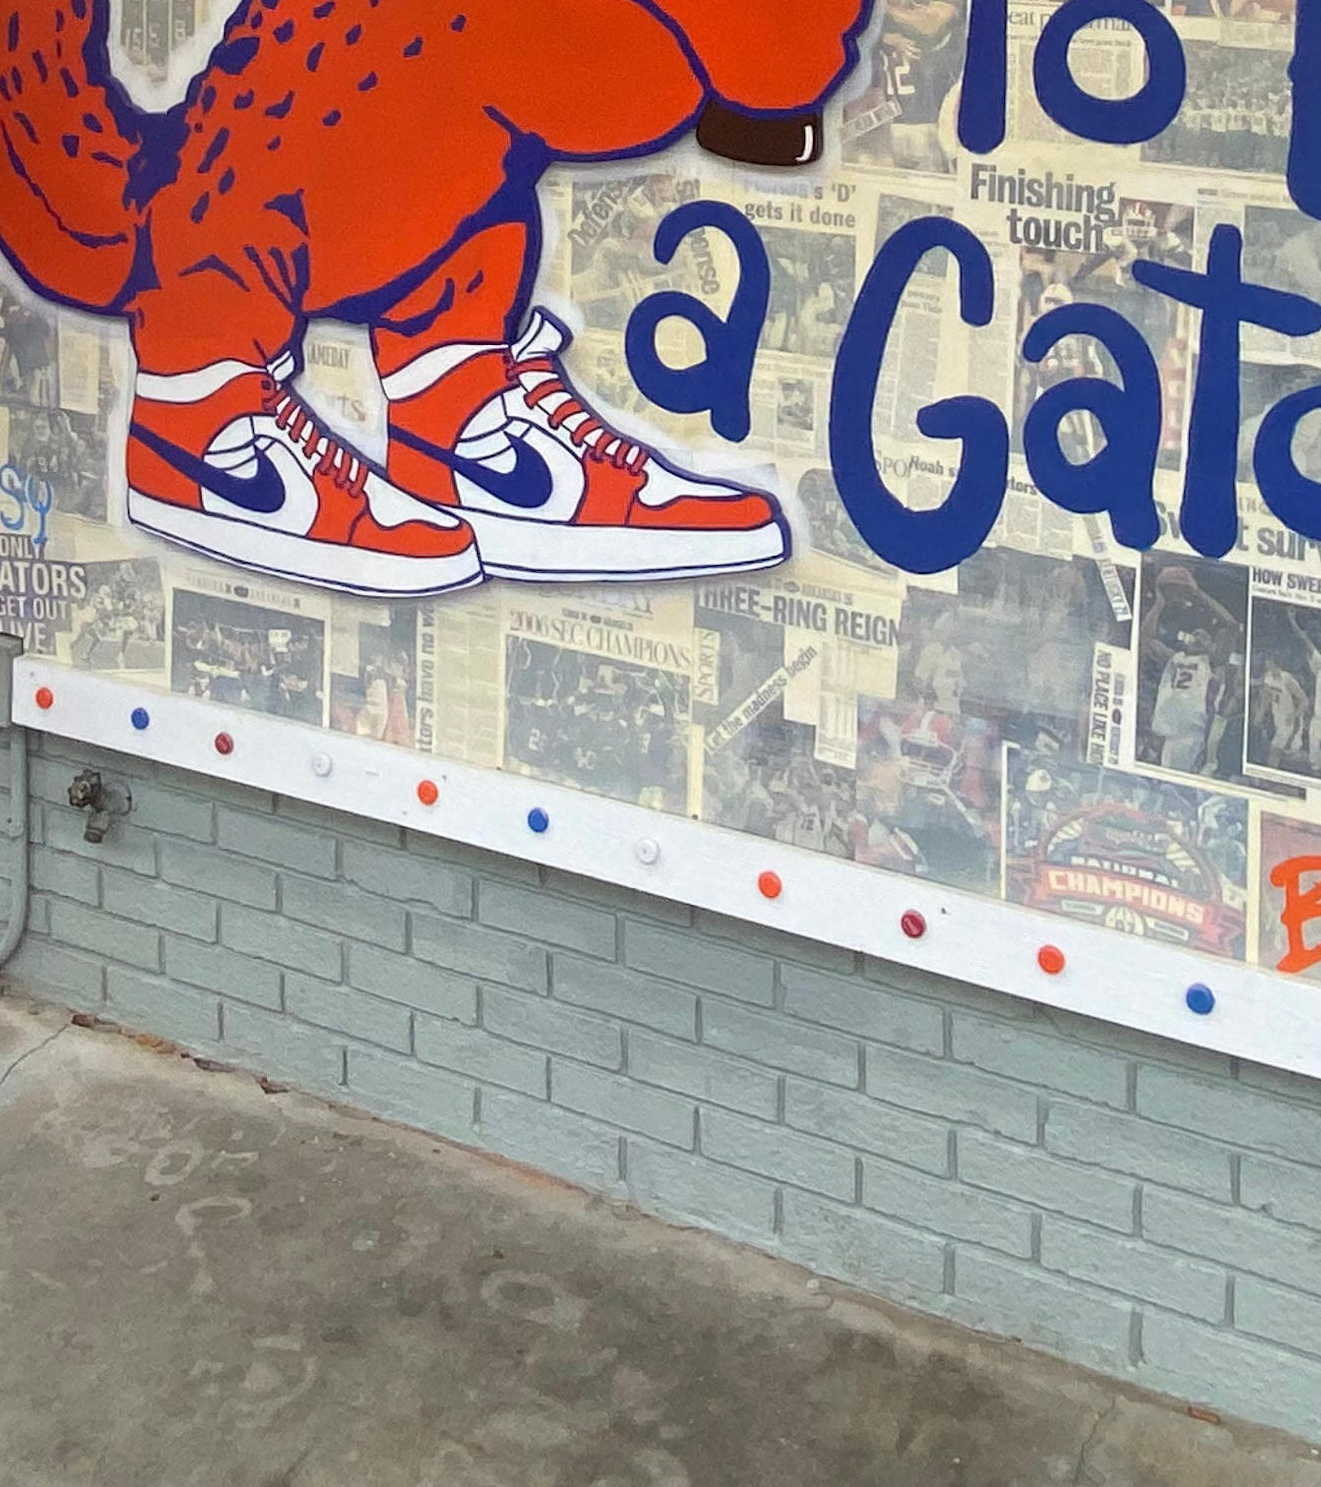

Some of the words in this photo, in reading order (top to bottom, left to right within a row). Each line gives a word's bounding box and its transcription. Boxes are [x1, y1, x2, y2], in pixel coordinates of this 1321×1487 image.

[745, 202, 784, 222] gets
[789, 203, 804, 223] it
[809, 205, 857, 228] done
[969, 162, 1118, 225] Finishing
[1005, 208, 1107, 253] touch
[1252, 566, 1284, 588] HOW
[32, 597, 69, 620] OUT
[698, 585, 828, 633] THREE-RING
[834, 607, 901, 647] REIGN
[509, 609, 549, 637] 2006
[551, 616, 585, 644] SEC
[586, 626, 691, 670] CHAMPIONS
[694, 629, 715, 700] SPORTS
[742, 673, 789, 723] madness
[785, 644, 819, 679] begin
[1047, 869, 1205, 924] CHAMPIONS
